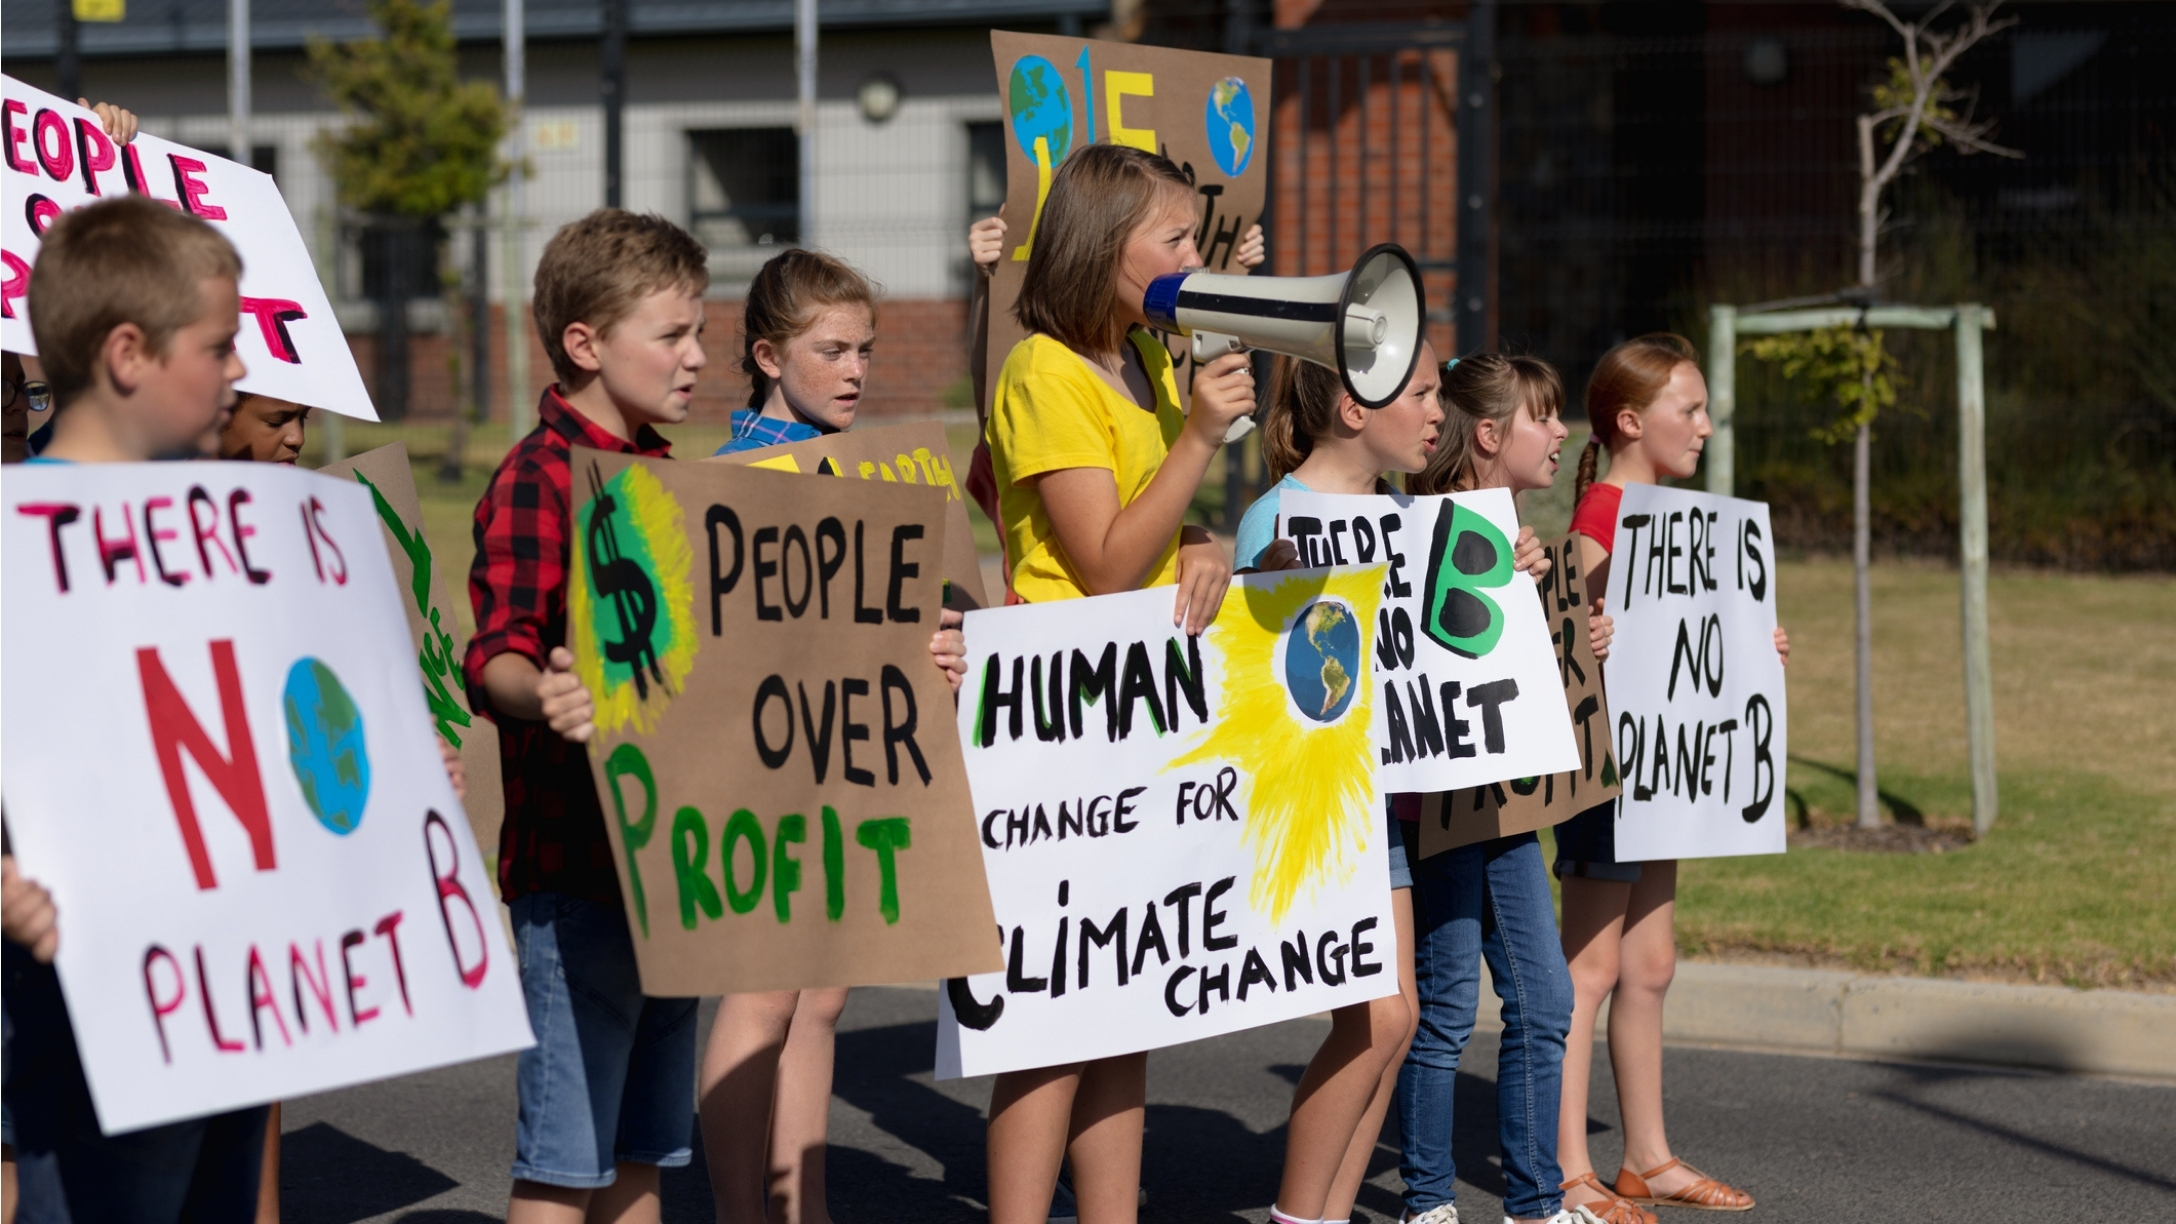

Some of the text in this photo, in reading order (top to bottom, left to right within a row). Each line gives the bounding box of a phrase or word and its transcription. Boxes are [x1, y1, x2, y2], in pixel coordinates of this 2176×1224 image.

[17, 484, 349, 595] THERE IS
[705, 503, 925, 638] PEOPLE
[1420, 497, 1514, 660] B
[1622, 506, 1767, 612] THERE IS
[972, 634, 1208, 748] HUMAN
[1667, 613, 1724, 704] NO
[753, 664, 932, 787] OVER
[1381, 671, 1520, 767] ANET
[1618, 711, 1738, 820] PLANET
[1741, 693, 1774, 824] B
[605, 742, 912, 940] PROFIT
[982, 766, 1240, 852] CHANGE FOR
[141, 808, 489, 1066] PLANET B
[1164, 916, 1383, 1018] CHANGE
